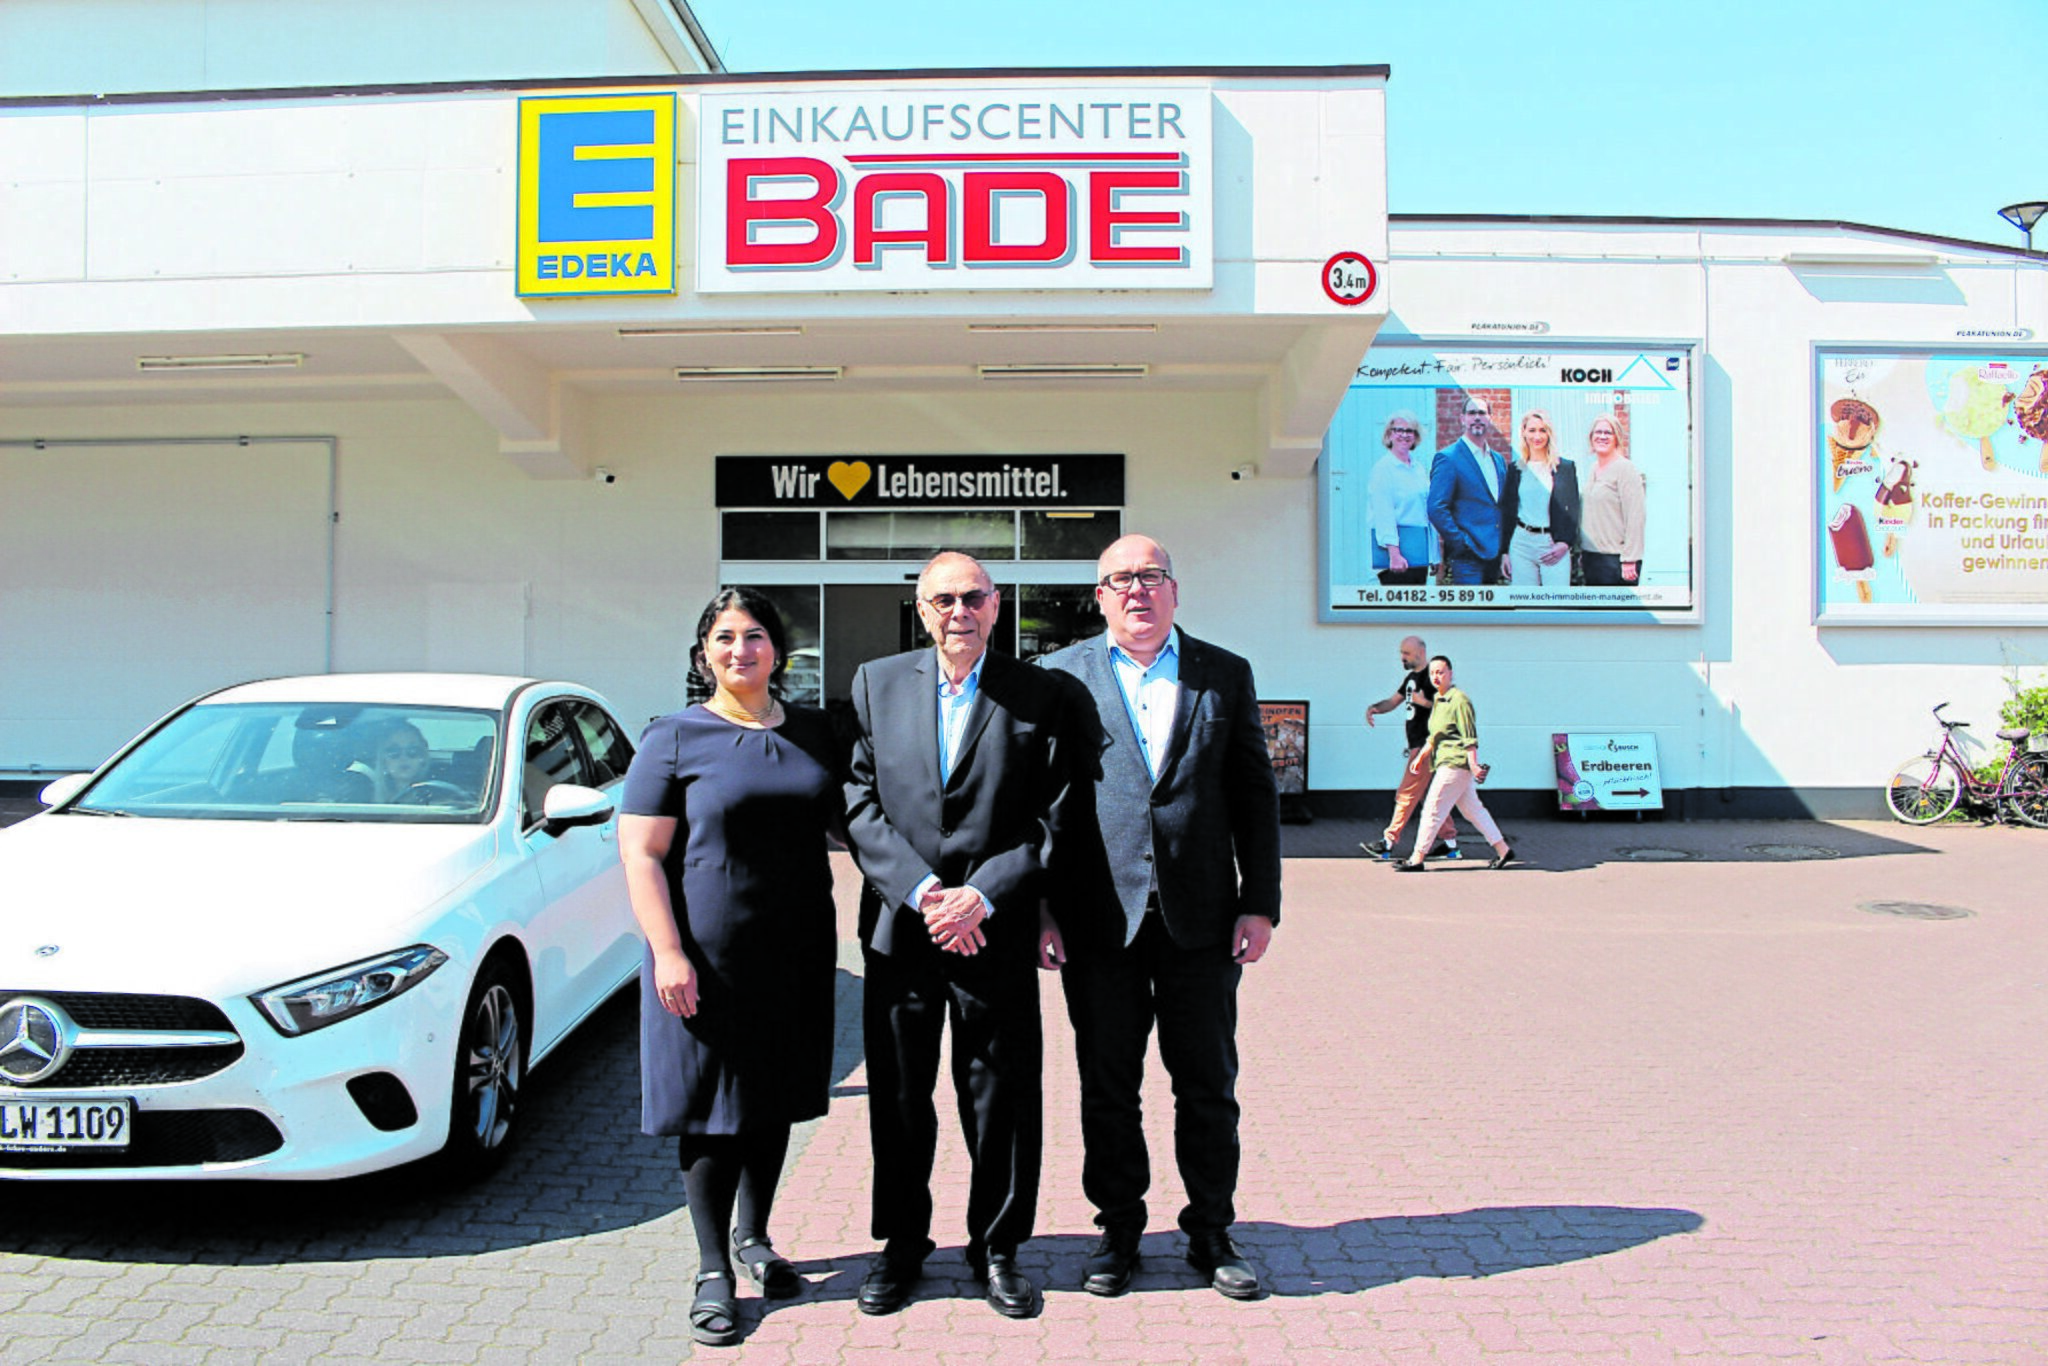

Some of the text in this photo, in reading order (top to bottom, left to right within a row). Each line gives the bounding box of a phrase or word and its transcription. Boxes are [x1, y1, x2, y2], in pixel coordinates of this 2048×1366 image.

[722, 102, 1187, 145] EINKAUFSCENTER
[724, 155, 1192, 272] BADE
[537, 253, 657, 280] EDEKA
[1561, 368, 1613, 383] KOCH
[1837, 465, 1873, 478] bueno
[771, 463, 1068, 499] Wir Lebensmittel.
[1928, 512, 1944, 529] in
[1949, 513, 2028, 533] Packung
[1961, 534, 2048, 550] und Urlau
[1357, 589, 1383, 602] Tel.
[1385, 589, 1428, 602] 04182
[1438, 589, 1455, 602] 95
[1458, 589, 1475, 602] 89
[1478, 589, 1495, 602] 10
[1509, 592, 1664, 602] www.koch-immobilien-management.de
[1580, 759, 1653, 772] Erdbeeren
[0, 1105, 125, 1140] LW 1109
